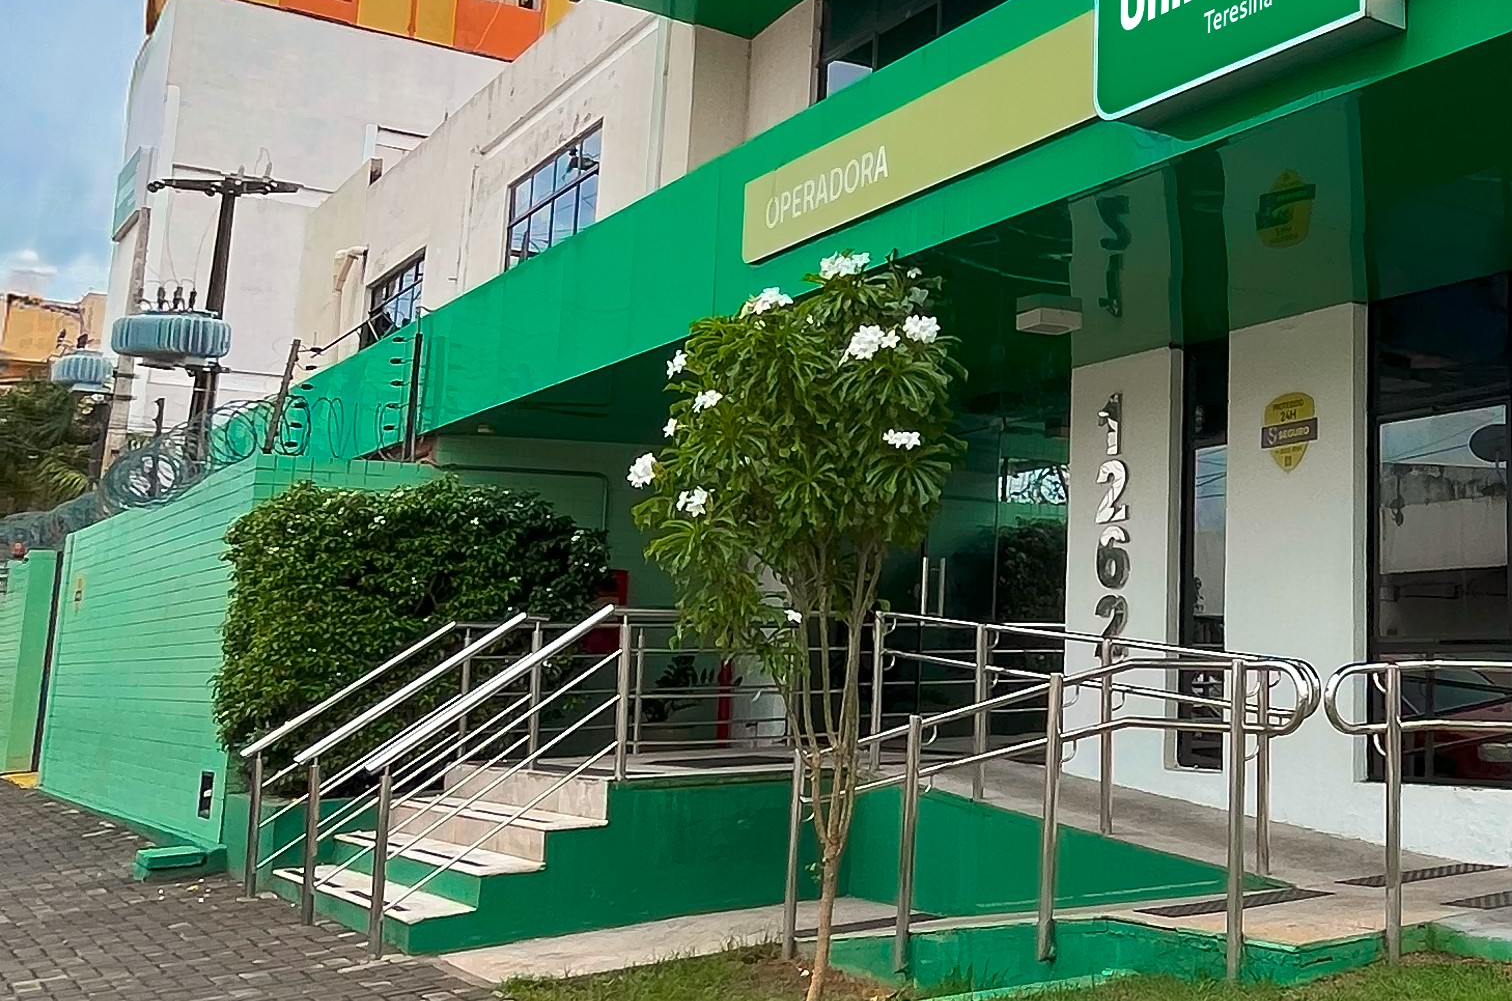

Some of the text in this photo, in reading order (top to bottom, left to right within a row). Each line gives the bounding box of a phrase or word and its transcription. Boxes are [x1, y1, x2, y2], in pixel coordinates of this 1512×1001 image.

[765, 145, 889, 229] OPERADORA
[1280, 409, 1297, 422] 24H
[1095, 392, 1131, 662] 1262
